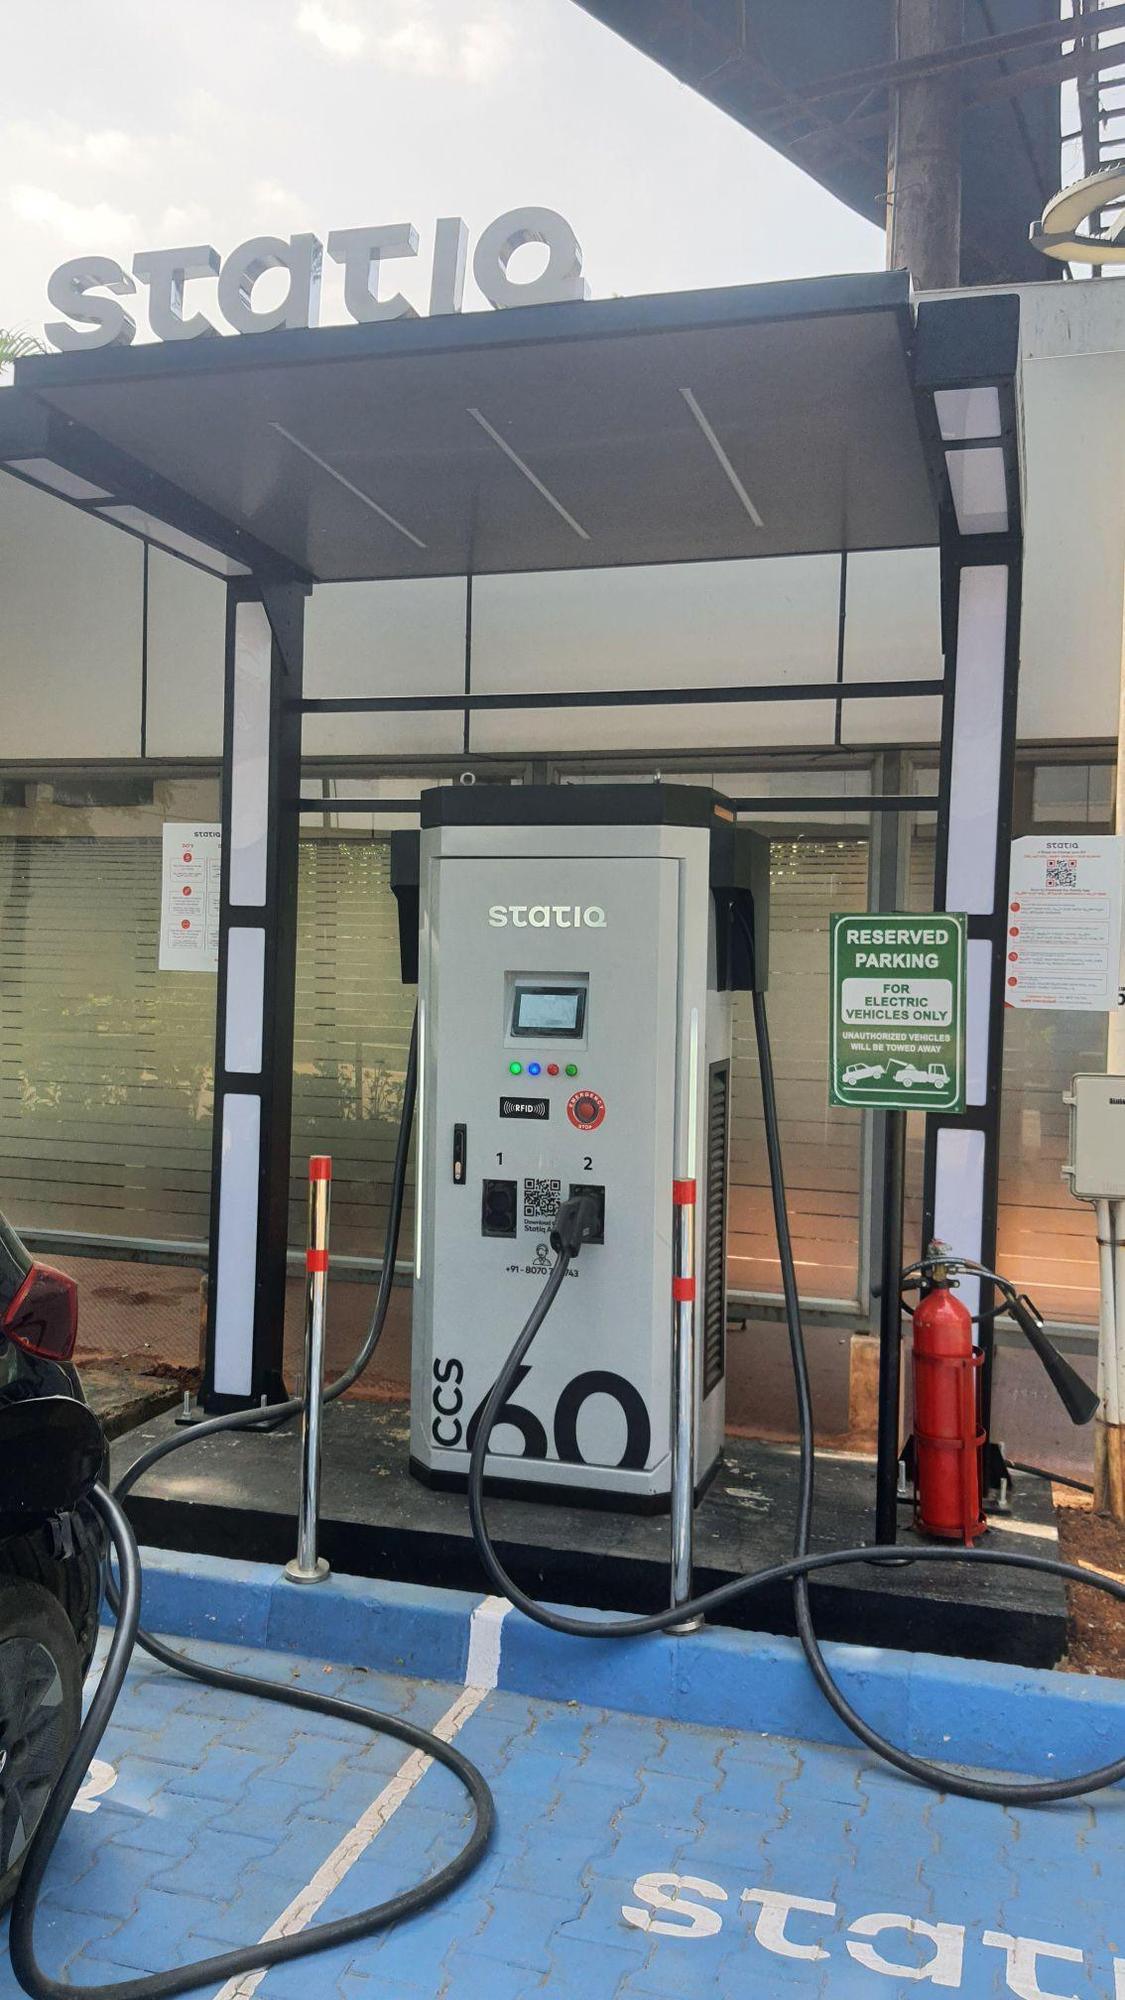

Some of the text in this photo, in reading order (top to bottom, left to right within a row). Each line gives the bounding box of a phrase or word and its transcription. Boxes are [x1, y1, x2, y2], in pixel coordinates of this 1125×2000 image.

[846, 929, 949, 945] RESERVED
[855, 953, 939, 969] PARKING
[883, 984, 910, 994] FOR
[864, 997, 928, 1008] ELECTRIC
[846, 1009, 948, 1021] VEHICLES ONLY
[842, 1031, 951, 1042] UNAUTHORIZED VEHICLES
[850, 1042, 942, 1053] WILL BE TOWED AWAY
[568, 1091, 604, 1109] EMERGENCY
[515, 1104, 534, 1113] RFID
[496, 1152, 503, 1165] 1
[583, 1156, 593, 1171] 2
[524, 1224, 546, 1233] Statiq
[432, 1357, 464, 1447] CCS
[466, 1365, 651, 1469] 60
